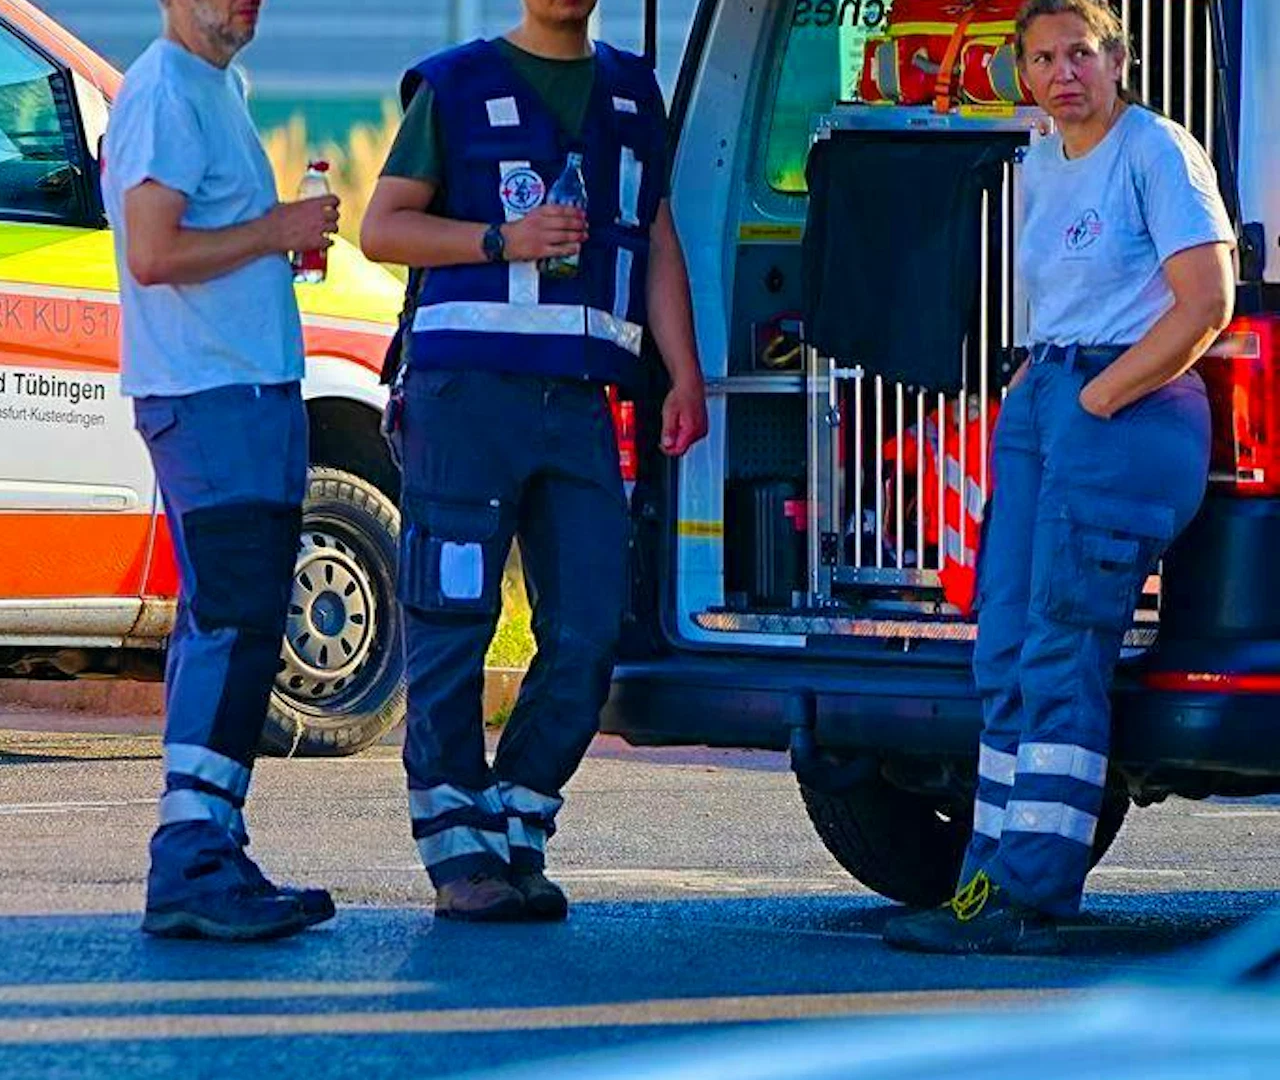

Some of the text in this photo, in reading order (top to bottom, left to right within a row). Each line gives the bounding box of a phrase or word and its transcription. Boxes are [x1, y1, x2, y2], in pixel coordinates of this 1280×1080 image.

[33, 300, 71, 333] KU
[81, 305, 120, 337] 51/
[13, 373, 106, 404] Tübingen
